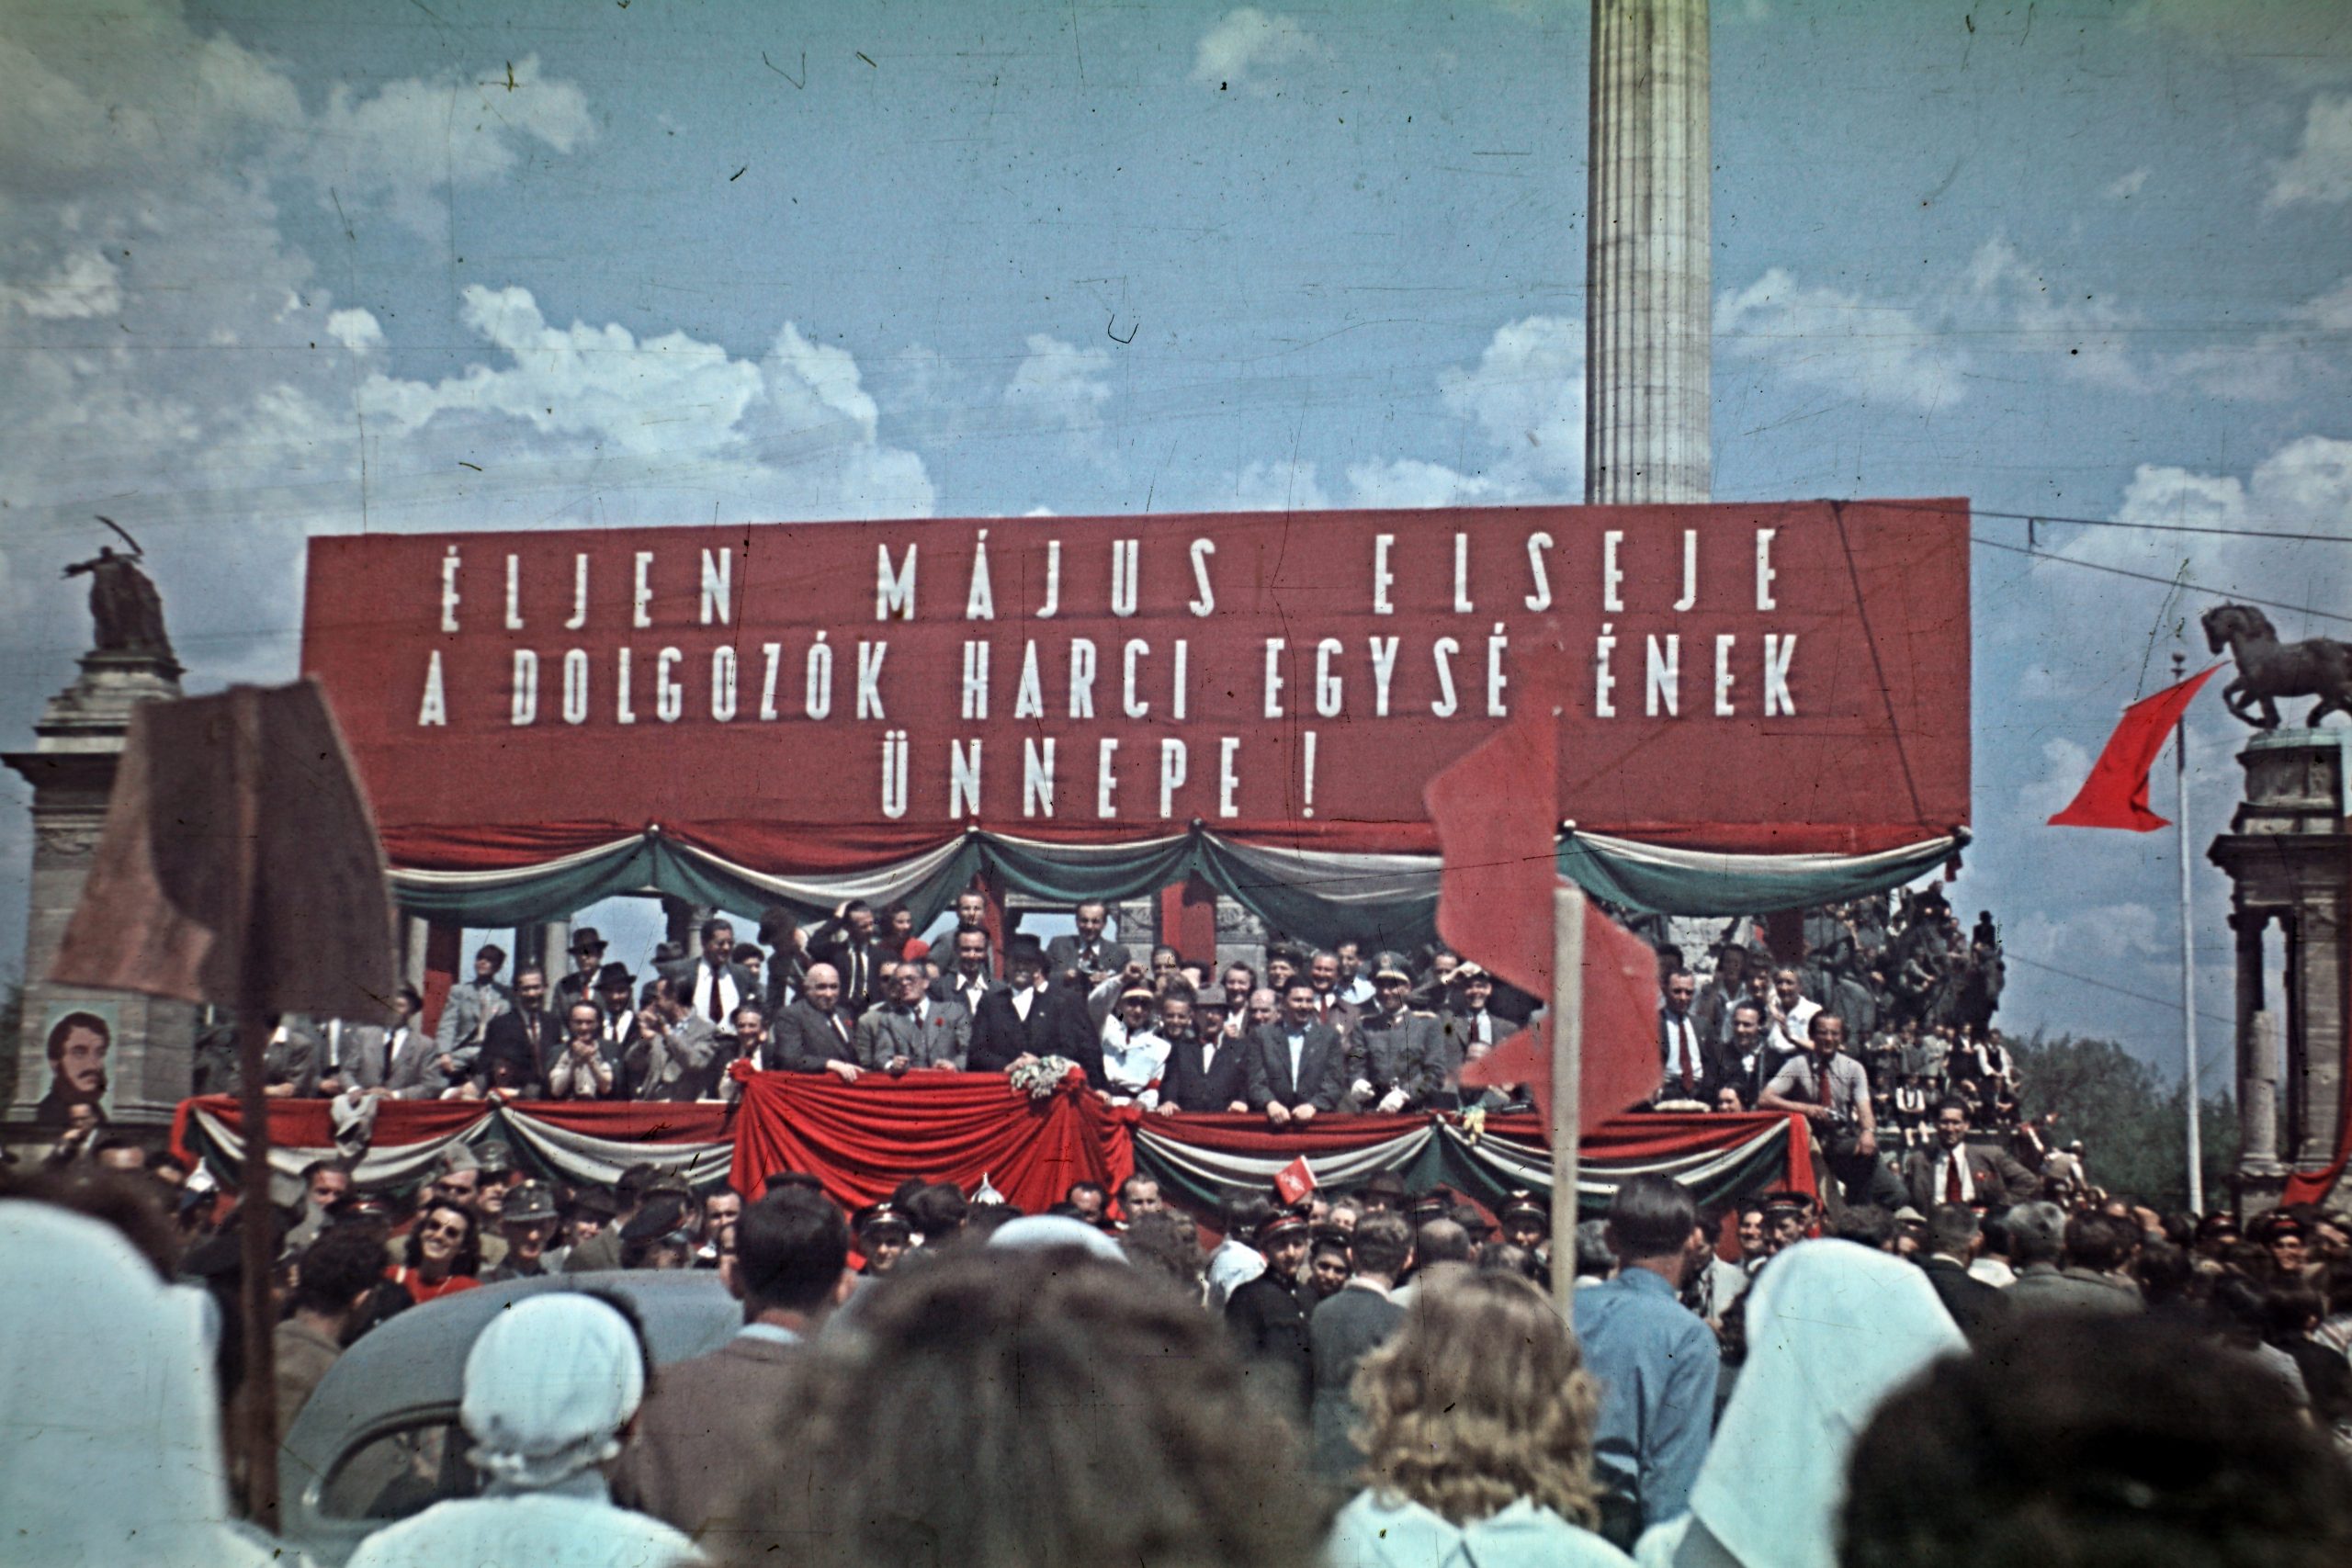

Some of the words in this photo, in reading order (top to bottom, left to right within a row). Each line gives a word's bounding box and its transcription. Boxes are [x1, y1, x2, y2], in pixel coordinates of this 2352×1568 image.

[441, 545, 732, 632] ÉLJEN
[876, 529, 1216, 622] MÁJUS
[1373, 527, 1777, 615] ELSEJE
[418, 649, 447, 727] A
[511, 631, 888, 726] DOLGOZÓK
[961, 637, 1189, 720] HARCI
[1263, 622, 1797, 718] EGYSÉÉNEK
[881, 728, 1317, 820] ÜNNEPE!
